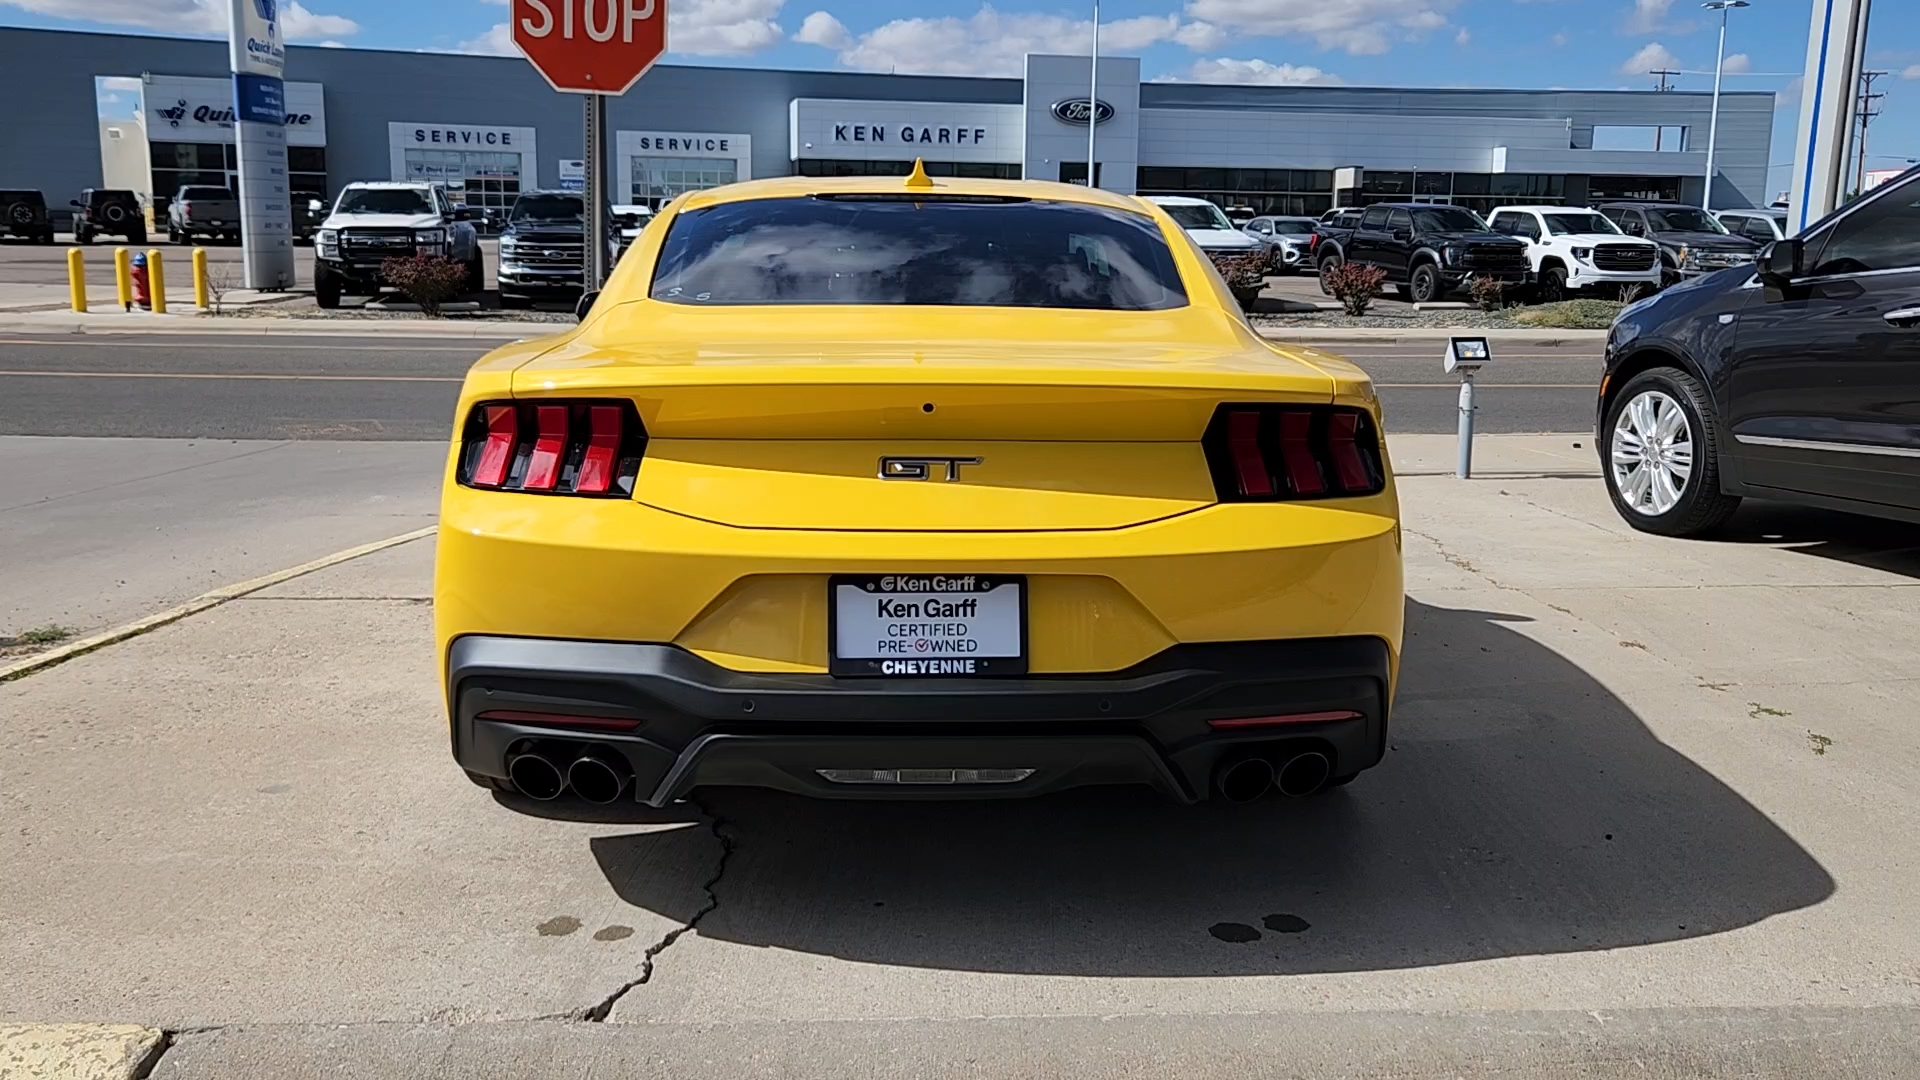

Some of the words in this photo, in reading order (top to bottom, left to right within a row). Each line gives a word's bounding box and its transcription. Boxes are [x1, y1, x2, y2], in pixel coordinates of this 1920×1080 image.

[521, 0, 656, 44] STOP
[247, 37, 270, 55] Quick
[193, 105, 236, 123] Qui
[285, 113, 312, 125] ne
[415, 129, 511, 145] SERVICE
[835, 124, 885, 142] KEN
[901, 126, 986, 144] GARFF
[640, 137, 730, 152] SERVICE
[877, 456, 984, 481] GT
[896, 576, 930, 591] Ken
[932, 576, 976, 591] Garff
[877, 599, 920, 618] Ken
[923, 598, 978, 618] Garff
[887, 623, 968, 637] CERTIFIED
[878, 638, 978, 654] PRE-OWNED
[881, 659, 976, 675] CHEYENNE
